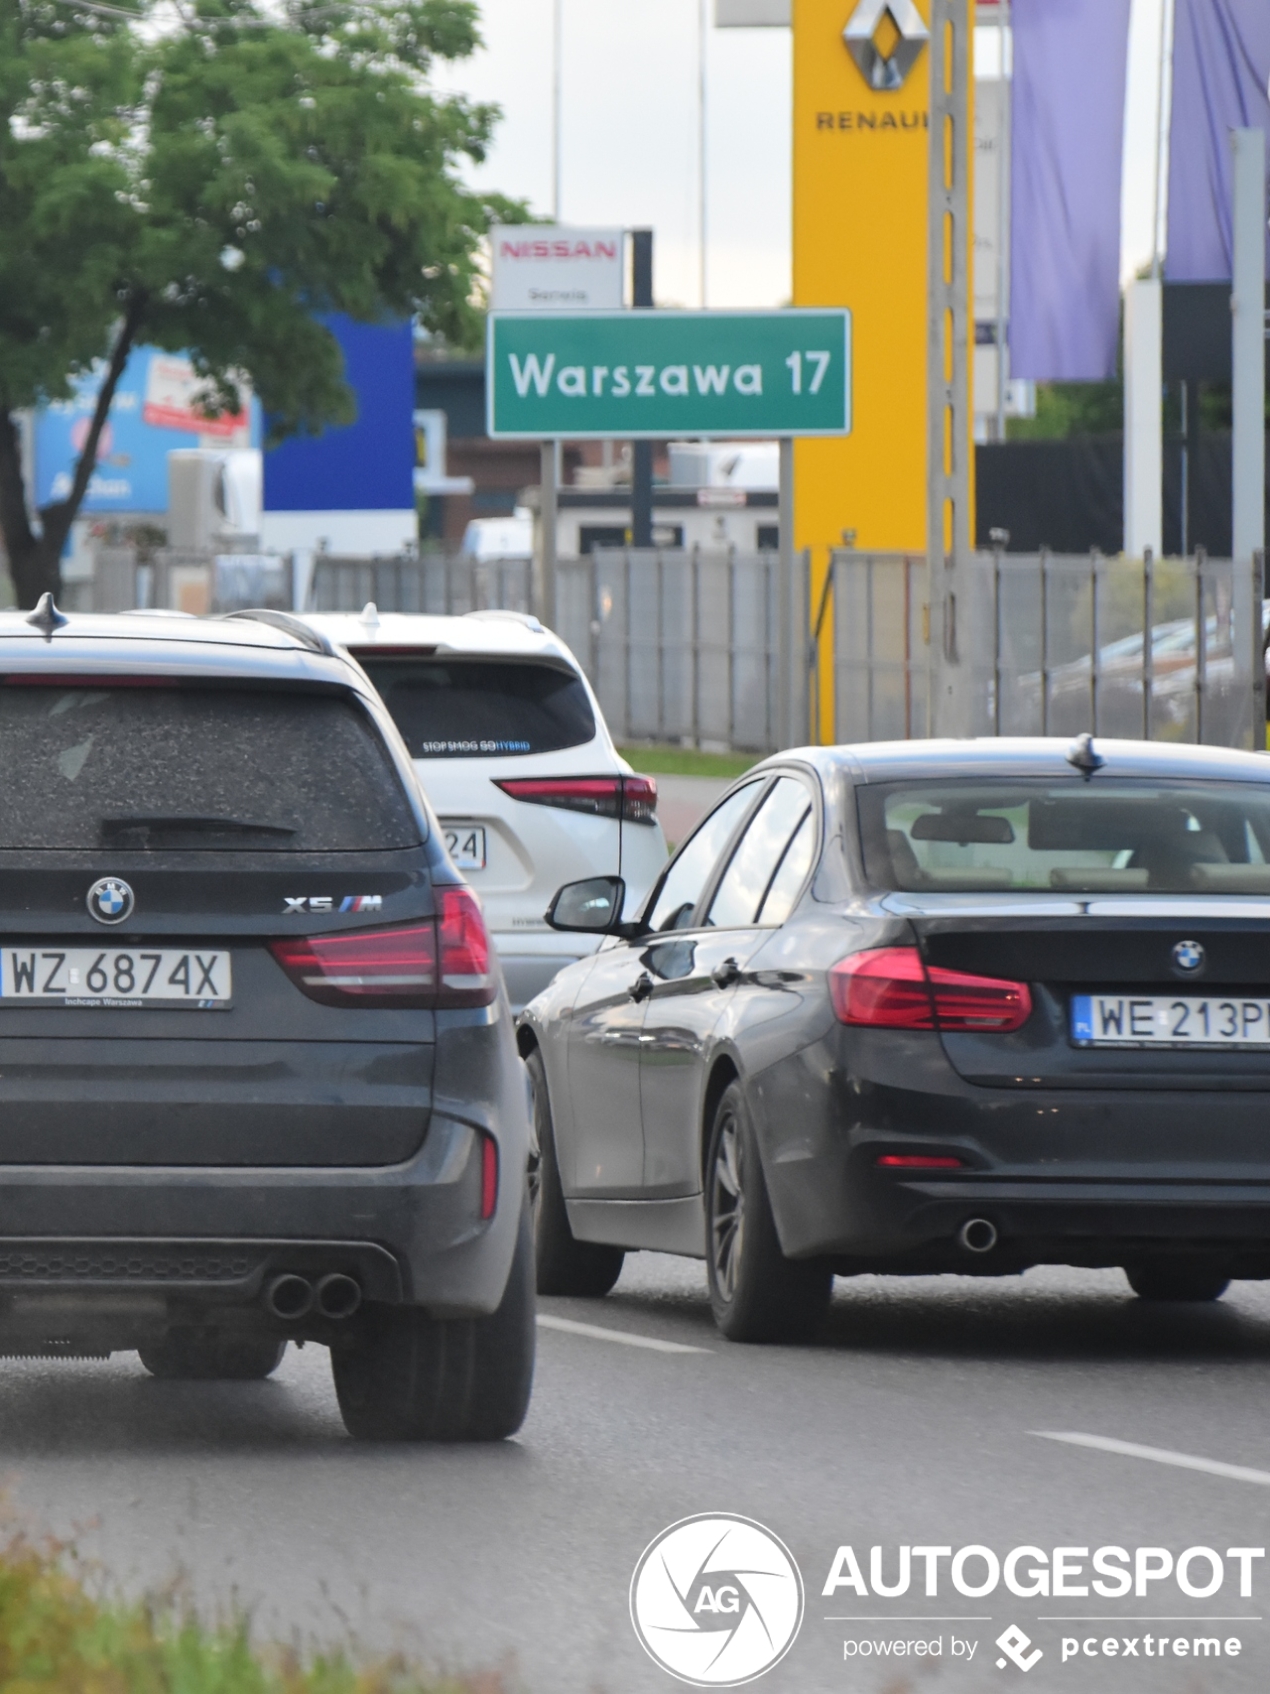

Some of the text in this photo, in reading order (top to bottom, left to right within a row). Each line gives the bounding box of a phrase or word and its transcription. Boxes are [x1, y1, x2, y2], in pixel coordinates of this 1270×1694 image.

[816, 110, 929, 130] RENAU
[500, 240, 617, 260] NISSAN
[508, 350, 831, 397] Warszawa 17
[282, 897, 333, 914] X5
[11, 952, 219, 996] WZ 6874X
[65, 998, 142, 1007] Inchcape Warszawa
[1099, 1000, 1270, 1038] WE 213P
